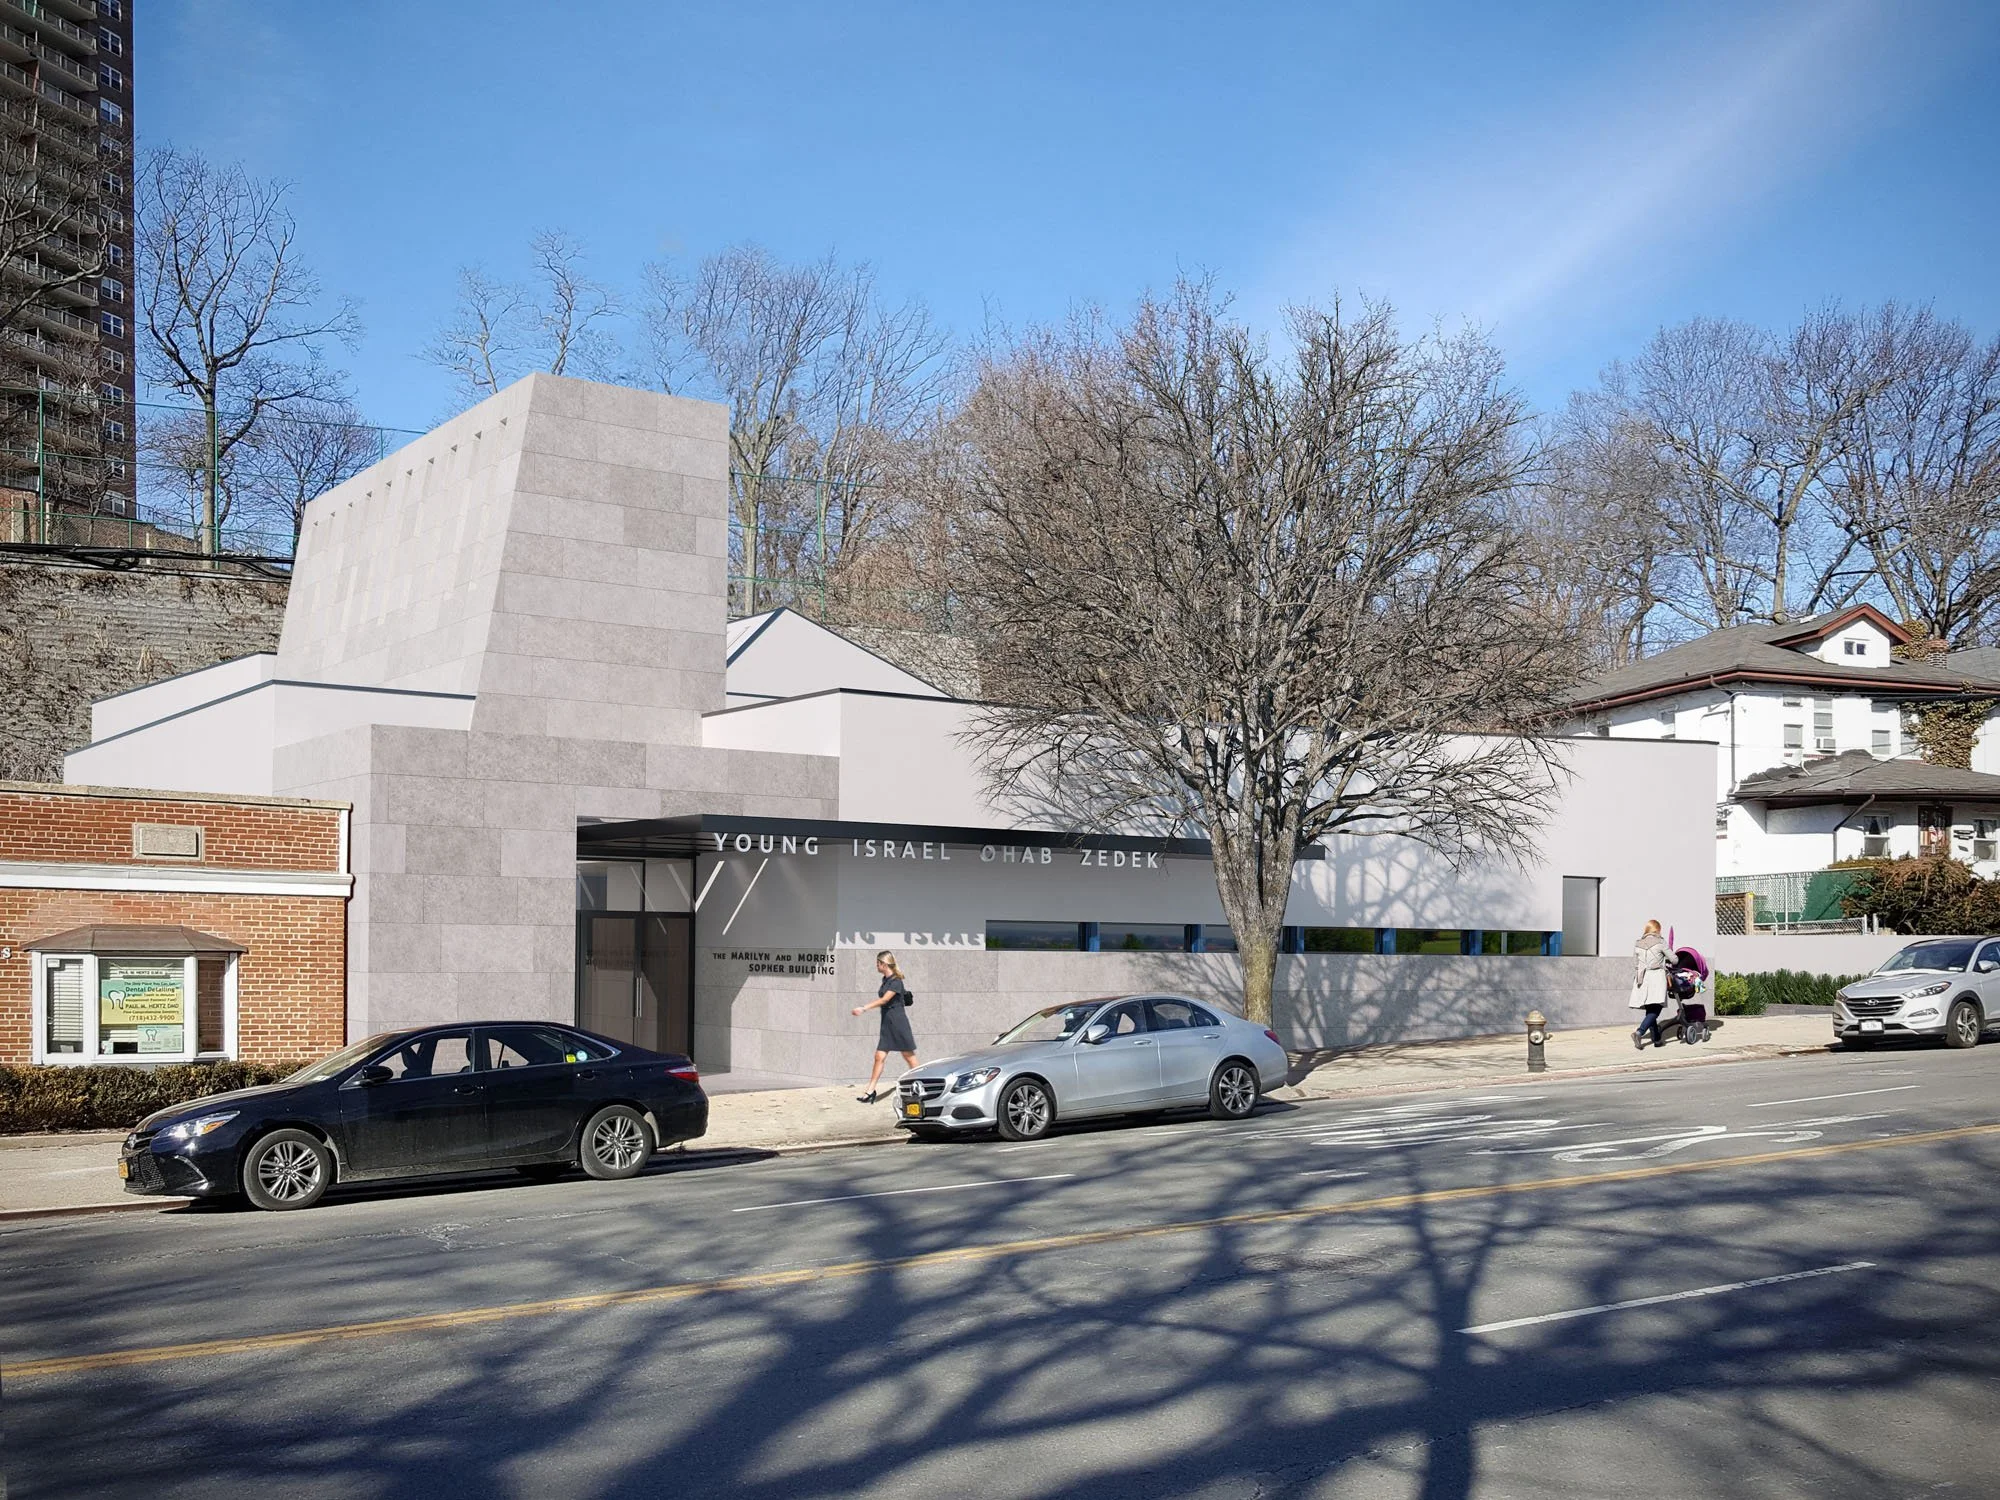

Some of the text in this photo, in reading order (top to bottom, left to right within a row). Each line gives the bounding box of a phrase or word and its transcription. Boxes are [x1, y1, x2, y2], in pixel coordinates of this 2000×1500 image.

[714, 832, 1158, 869] YOUNG ISRAEL OHAB ZEDEK
[731, 952, 770, 961] MARILYN
[775, 954, 792, 962] AND
[798, 953, 835, 963] MORRIS
[749, 963, 835, 975] SOPHER BUILDING
